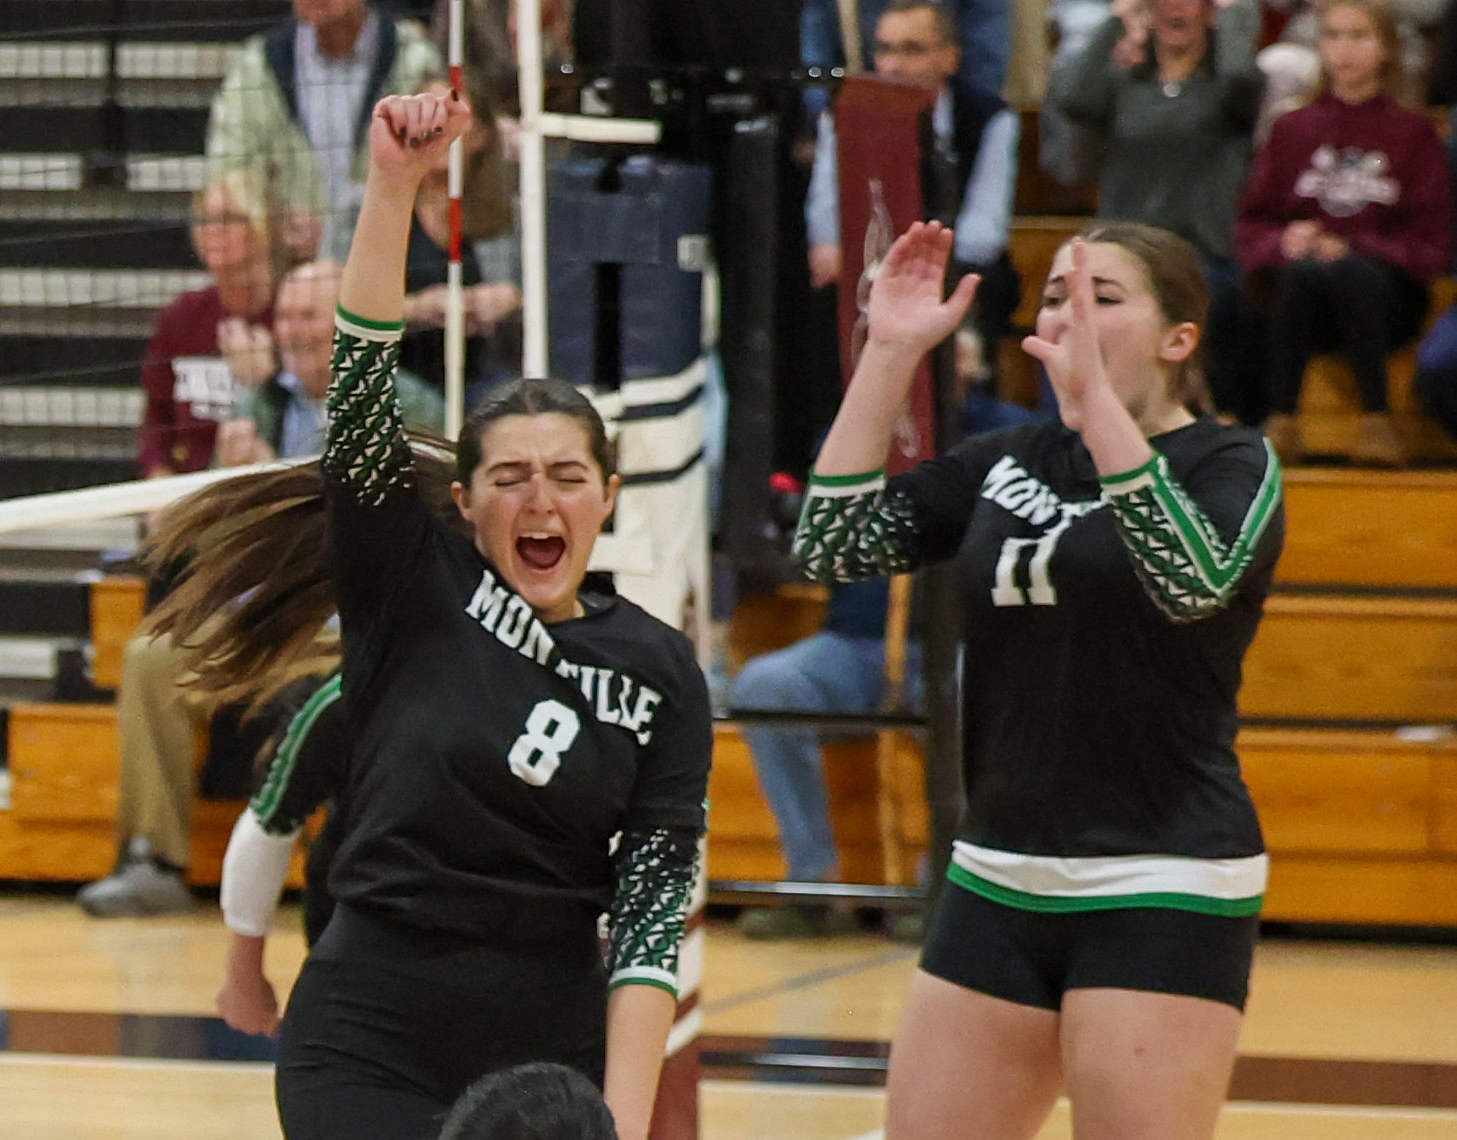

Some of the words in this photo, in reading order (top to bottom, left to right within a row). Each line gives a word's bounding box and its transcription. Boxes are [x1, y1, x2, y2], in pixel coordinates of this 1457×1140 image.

[990, 535, 1057, 607] 11
[463, 568, 664, 746] MONILLE
[507, 699, 581, 787] 8
